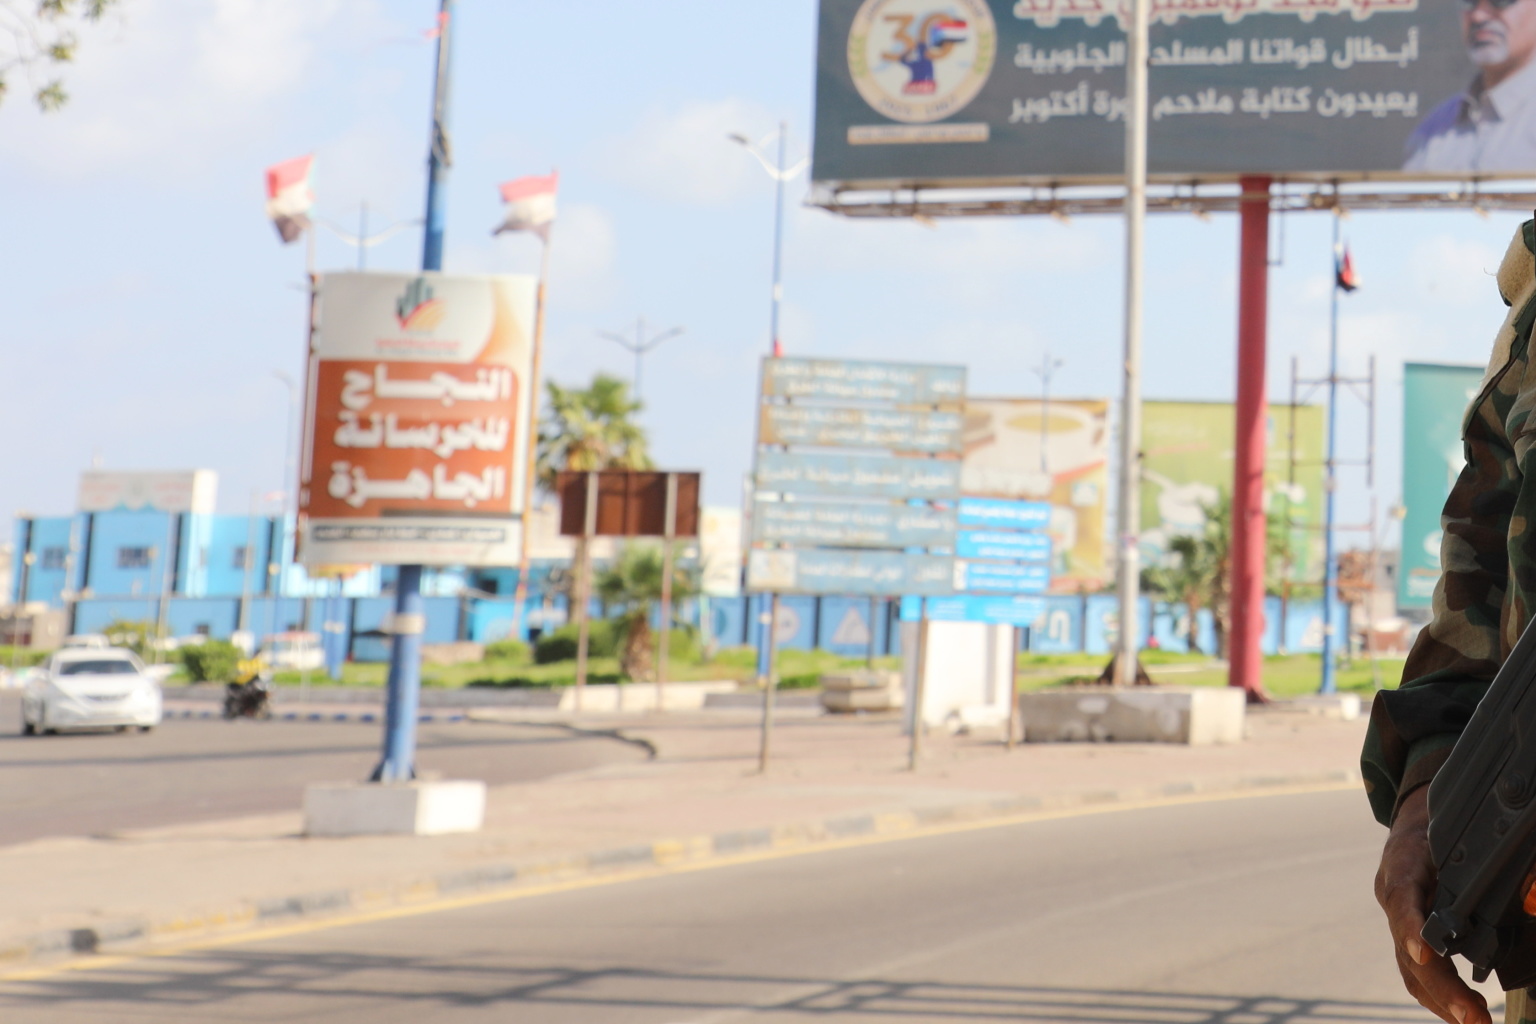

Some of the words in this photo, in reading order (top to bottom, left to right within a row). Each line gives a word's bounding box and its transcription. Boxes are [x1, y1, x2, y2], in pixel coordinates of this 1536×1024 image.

[1014, 40, 1126, 74] الجنوبية
[1150, 39, 1244, 65] المسلح
[1251, 38, 1327, 69] قواتنا
[1332, 27, 1419, 69] أبطال
[1008, 80, 1090, 124] أكتوبر
[1093, 90, 1134, 121] ورة
[1153, 87, 1235, 121] ملاحم
[1240, 86, 1312, 119] كتابة
[1317, 88, 1418, 118] يعيدون
[341, 364, 513, 410] النجاح
[333, 410, 510, 459] للخرسانة
[327, 460, 506, 508] الجاهزة
